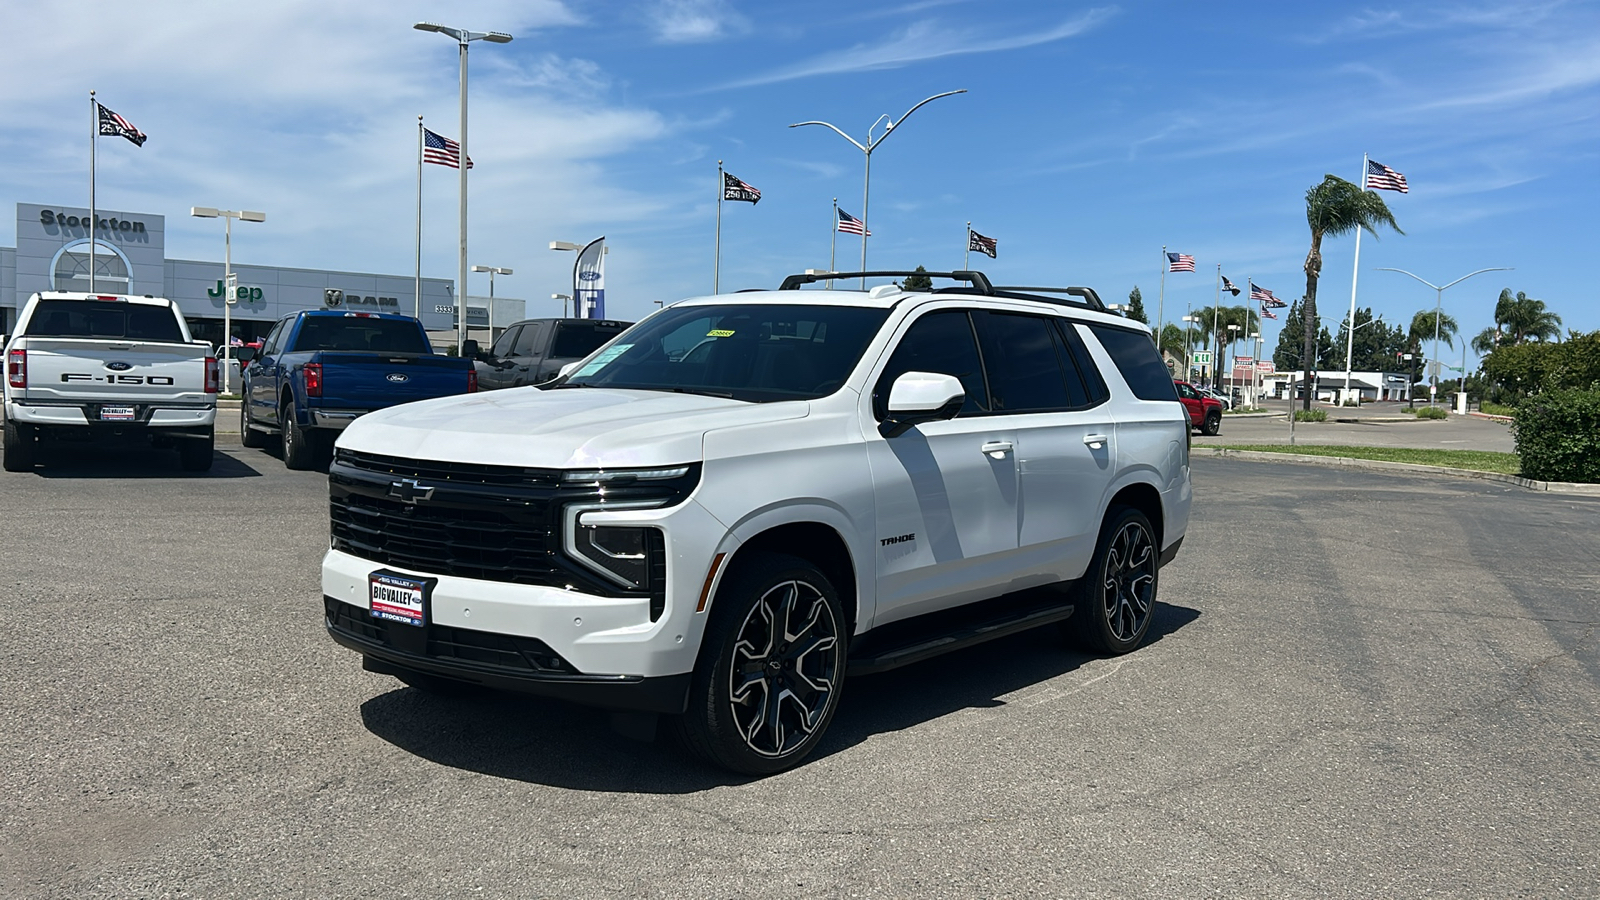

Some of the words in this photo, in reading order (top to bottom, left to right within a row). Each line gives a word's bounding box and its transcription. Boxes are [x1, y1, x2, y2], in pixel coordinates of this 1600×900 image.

[40, 210, 145, 233] Stockton
[207, 280, 263, 303] Jep
[346, 295, 398, 306] RAM
[435, 305, 453, 313] 3333
[61, 373, 174, 385] F-150
[880, 533, 916, 546] TAHOE
[373, 586, 412, 605] BIGVALLEY
[381, 612, 411, 623] STOCKTON
